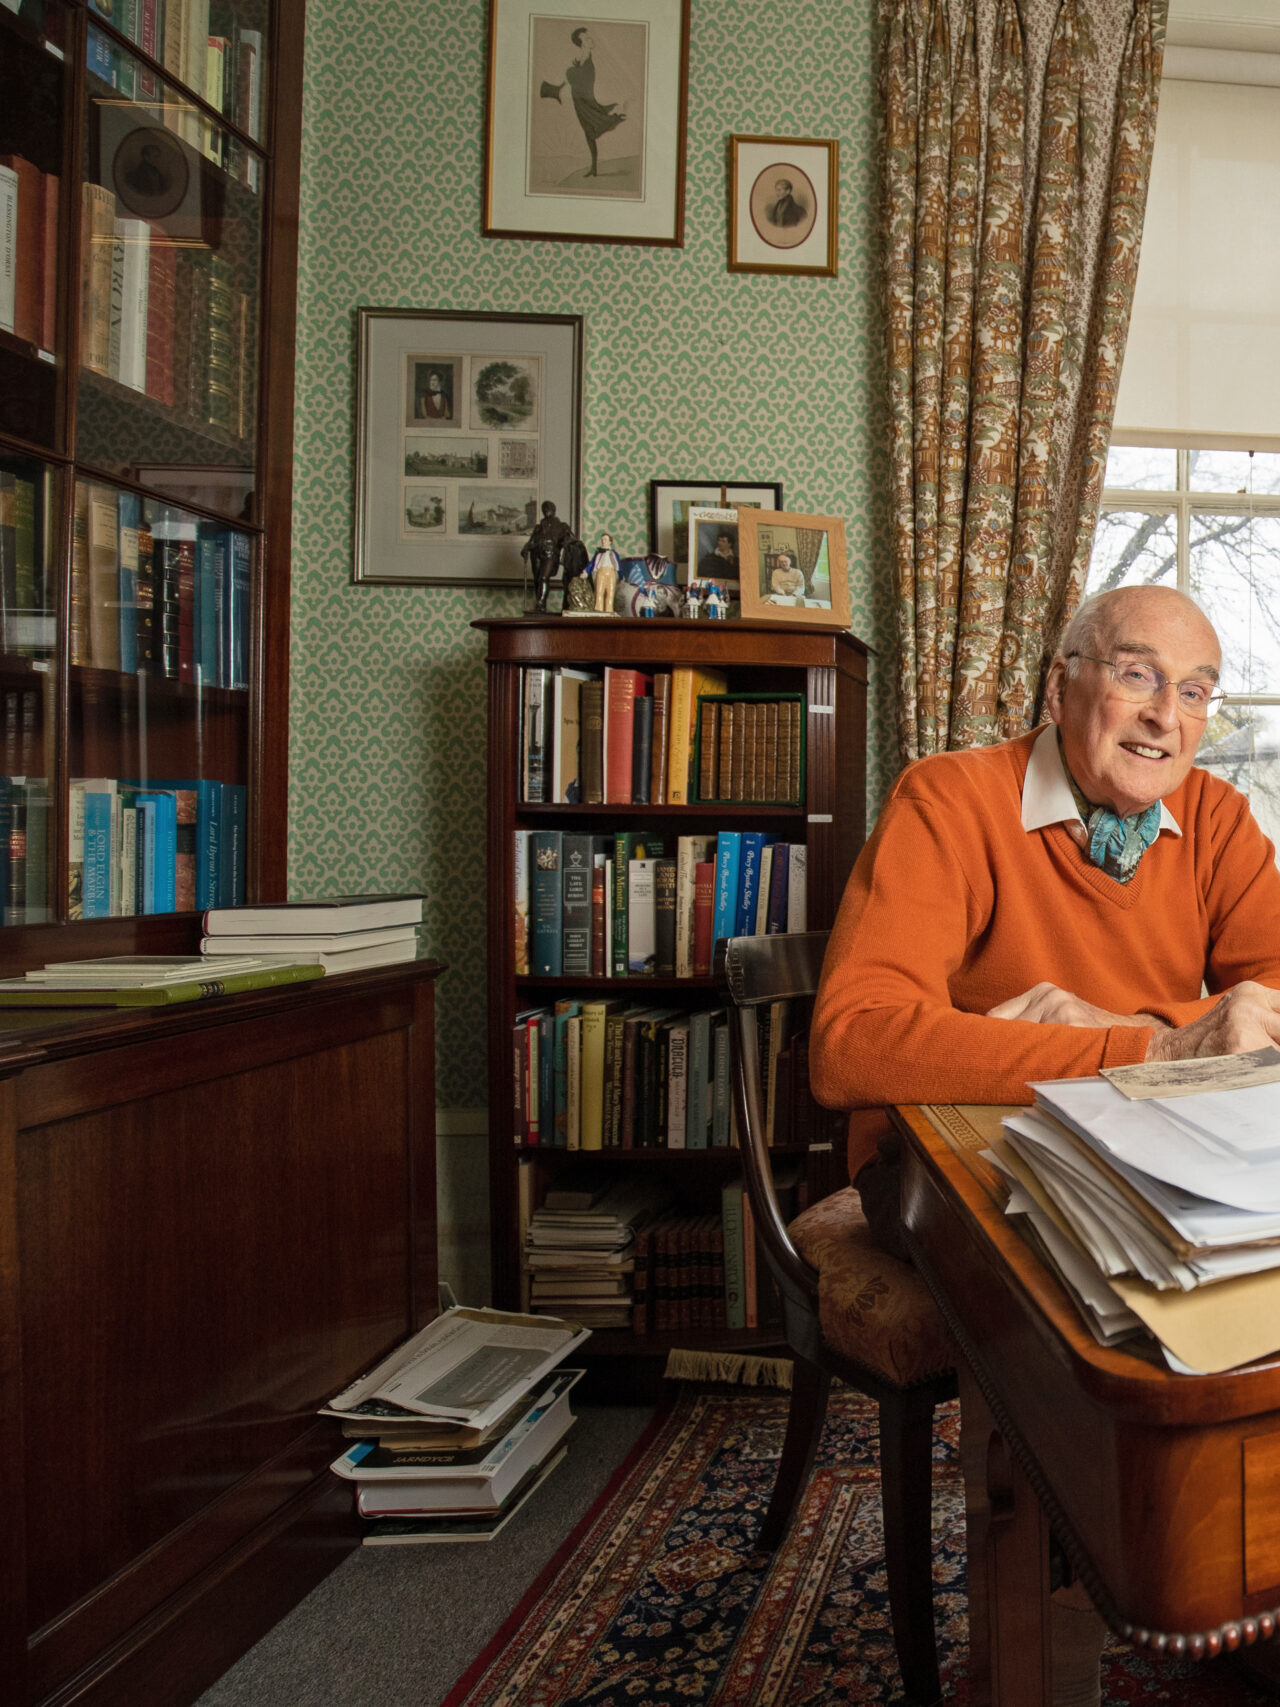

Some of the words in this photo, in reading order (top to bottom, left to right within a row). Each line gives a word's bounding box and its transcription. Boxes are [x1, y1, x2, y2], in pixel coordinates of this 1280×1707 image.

[209, 821, 218, 843] Lord
[87, 839, 97, 863] THE
[96, 829, 106, 861] LORD
[615, 839, 625, 874] Ireland's
[207, 845, 218, 878] Byron's
[721, 850, 731, 868] Percy
[744, 850, 755, 868] Percy
[86, 863, 98, 917] MARBLES
[96, 863, 106, 900] ELGIN
[721, 868, 731, 890] Bysshe
[744, 867, 753, 889] Bysshe
[206, 879, 218, 909] Streng
[615, 876, 625, 911] Minstrel
[719, 890, 729, 911] Shelley
[742, 888, 752, 910] Shelley
[671, 1038, 685, 1078] DRACULA
[392, 1455, 455, 1464] JARNDYCE
